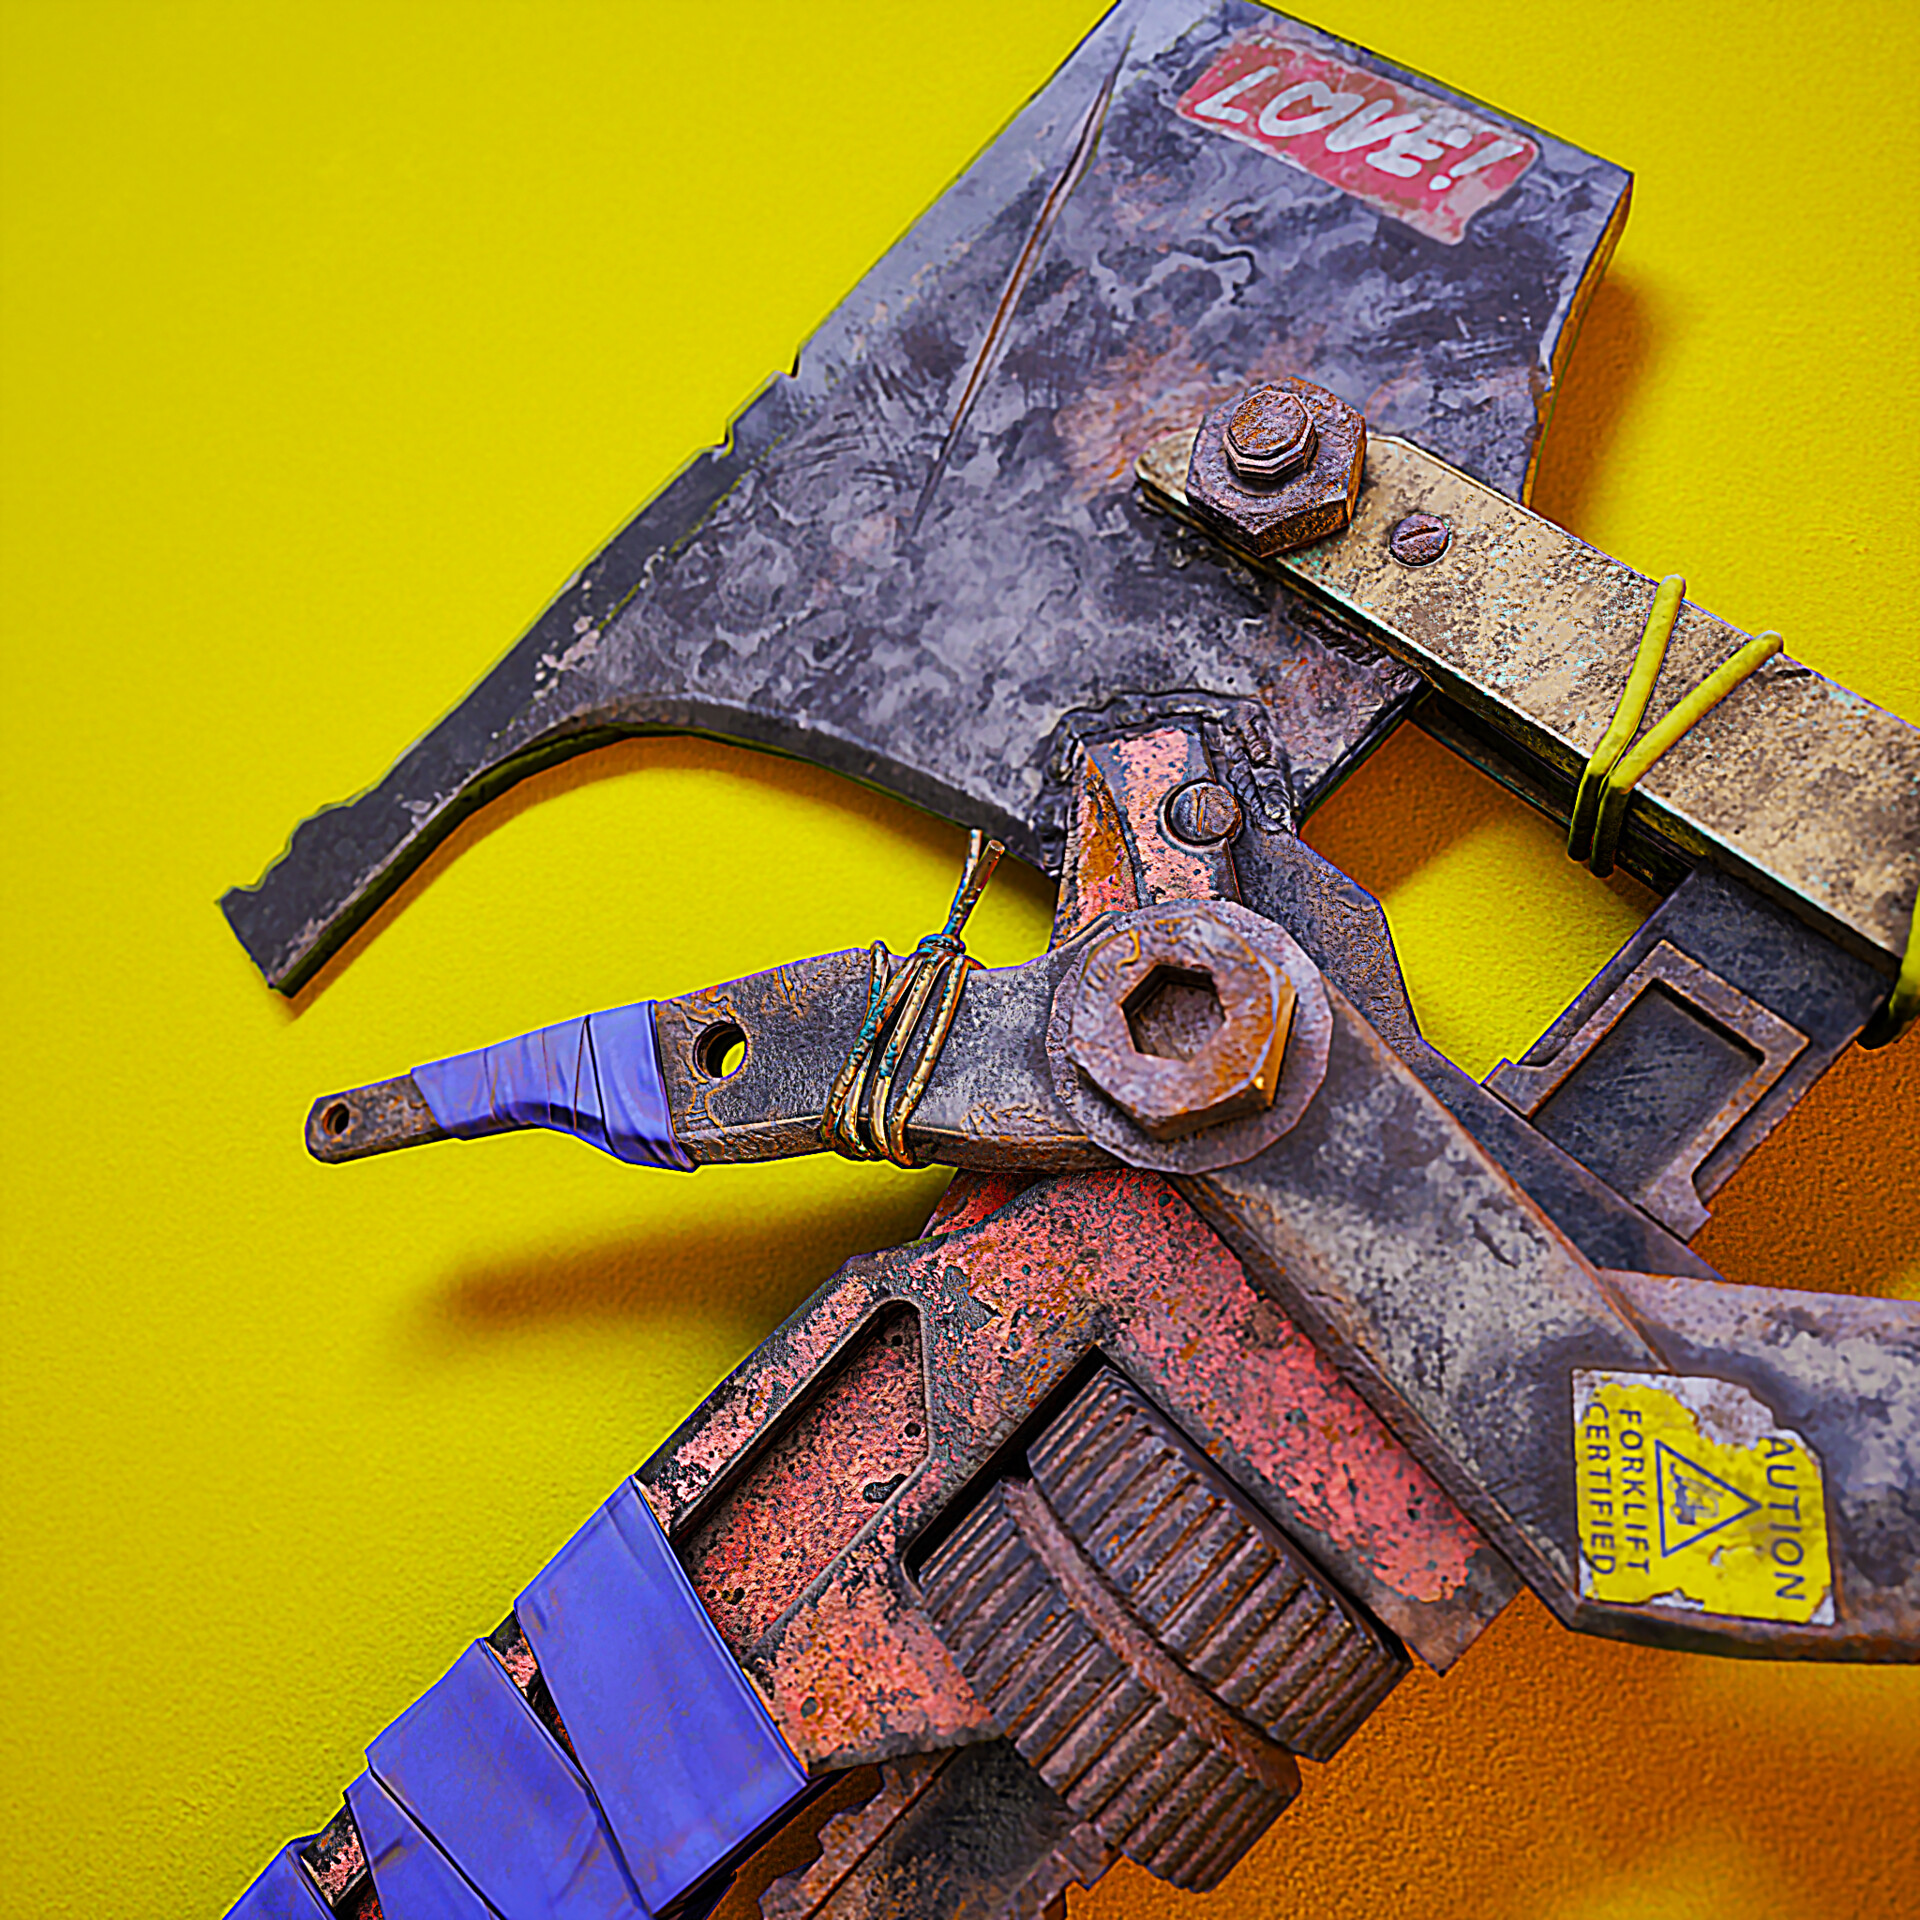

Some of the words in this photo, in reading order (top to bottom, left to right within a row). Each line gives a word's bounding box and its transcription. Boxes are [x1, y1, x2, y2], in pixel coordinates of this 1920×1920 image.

[1194, 65, 1525, 191] LOVE!
[1586, 1402, 1616, 1575] CERTIFIED
[1619, 1408, 1650, 1576] FORKLIFT
[1758, 1436, 1806, 1601] AUTION
